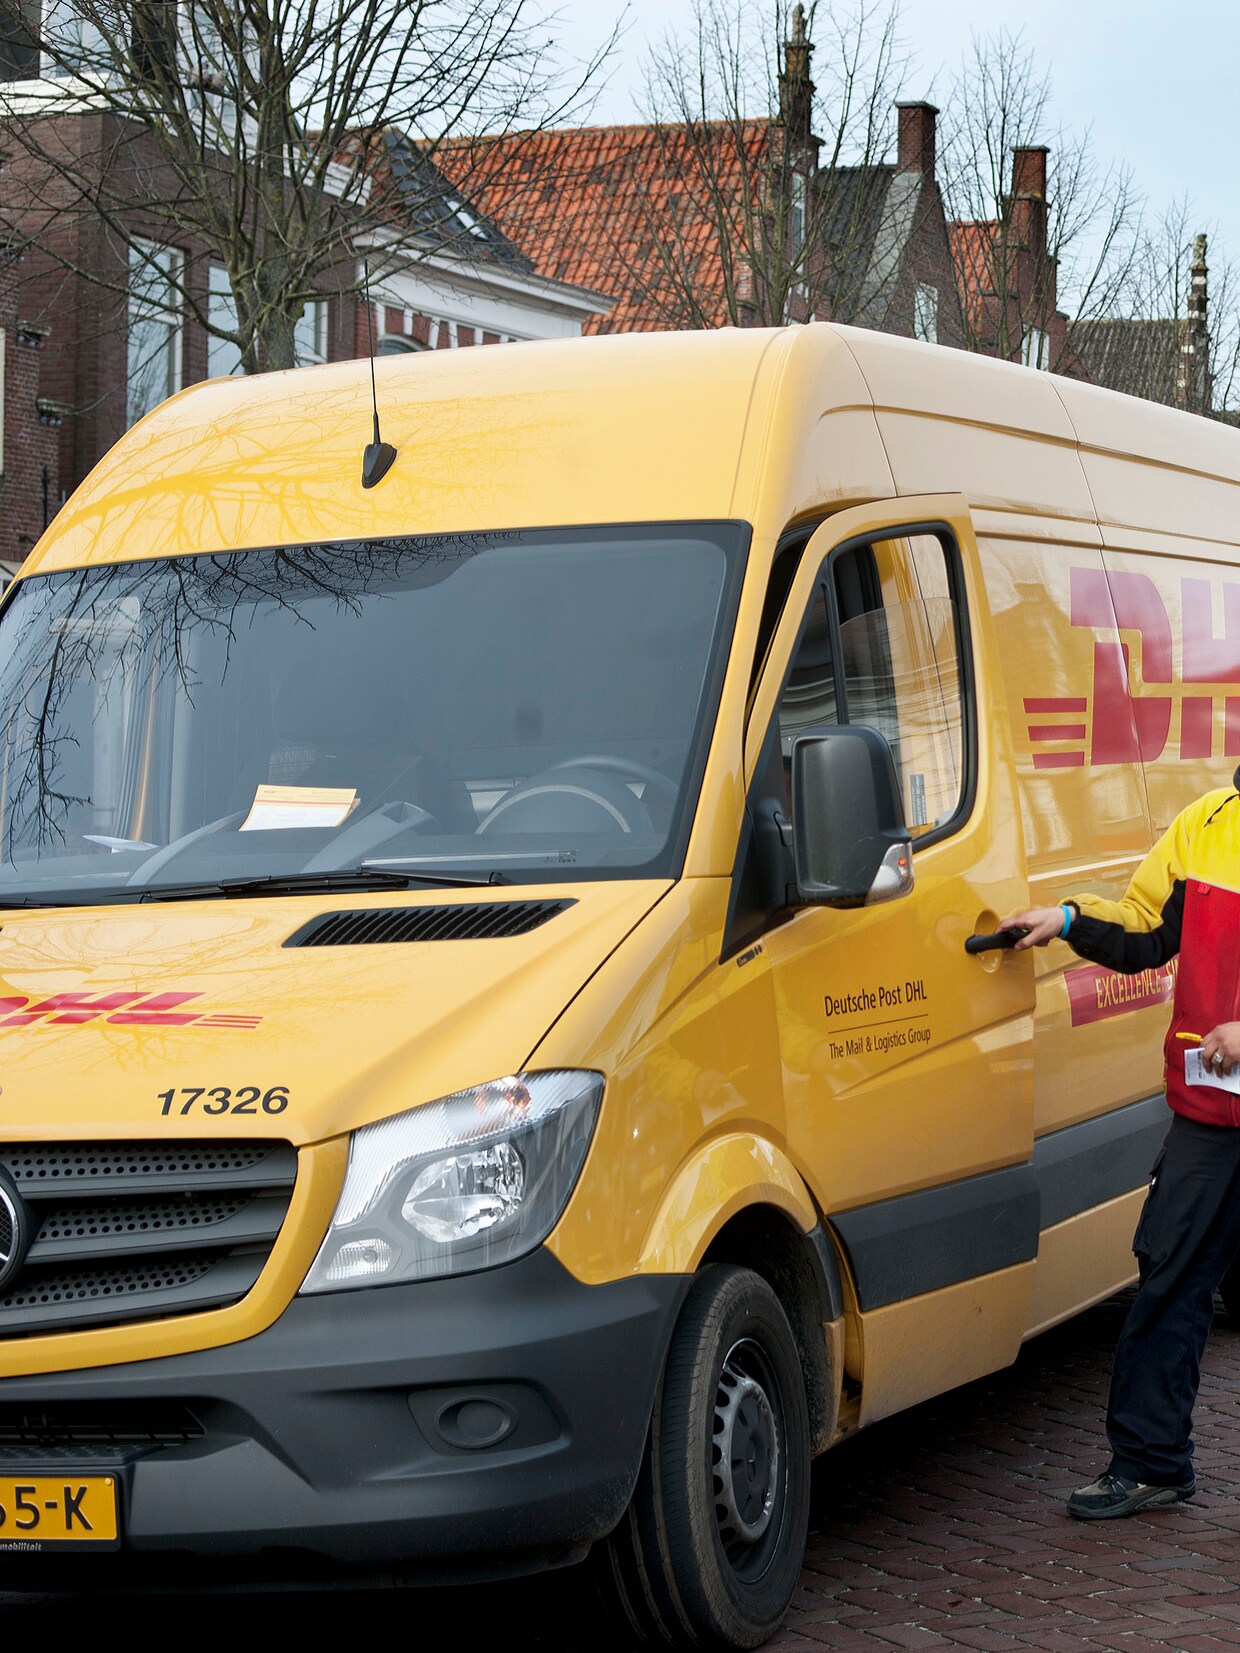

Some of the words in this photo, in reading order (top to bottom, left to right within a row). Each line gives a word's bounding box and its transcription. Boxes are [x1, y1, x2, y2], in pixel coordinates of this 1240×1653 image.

[824, 988, 877, 1017] Deutsche
[878, 985, 902, 1008] Post
[905, 979, 927, 1002] DHL
[829, 1042, 844, 1059] The
[845, 1036, 864, 1056] Mail
[865, 1035, 872, 1052] &
[873, 1031, 907, 1053] Logistics
[907, 1028, 932, 1045] Group
[157, 1086, 290, 1116] 17326
